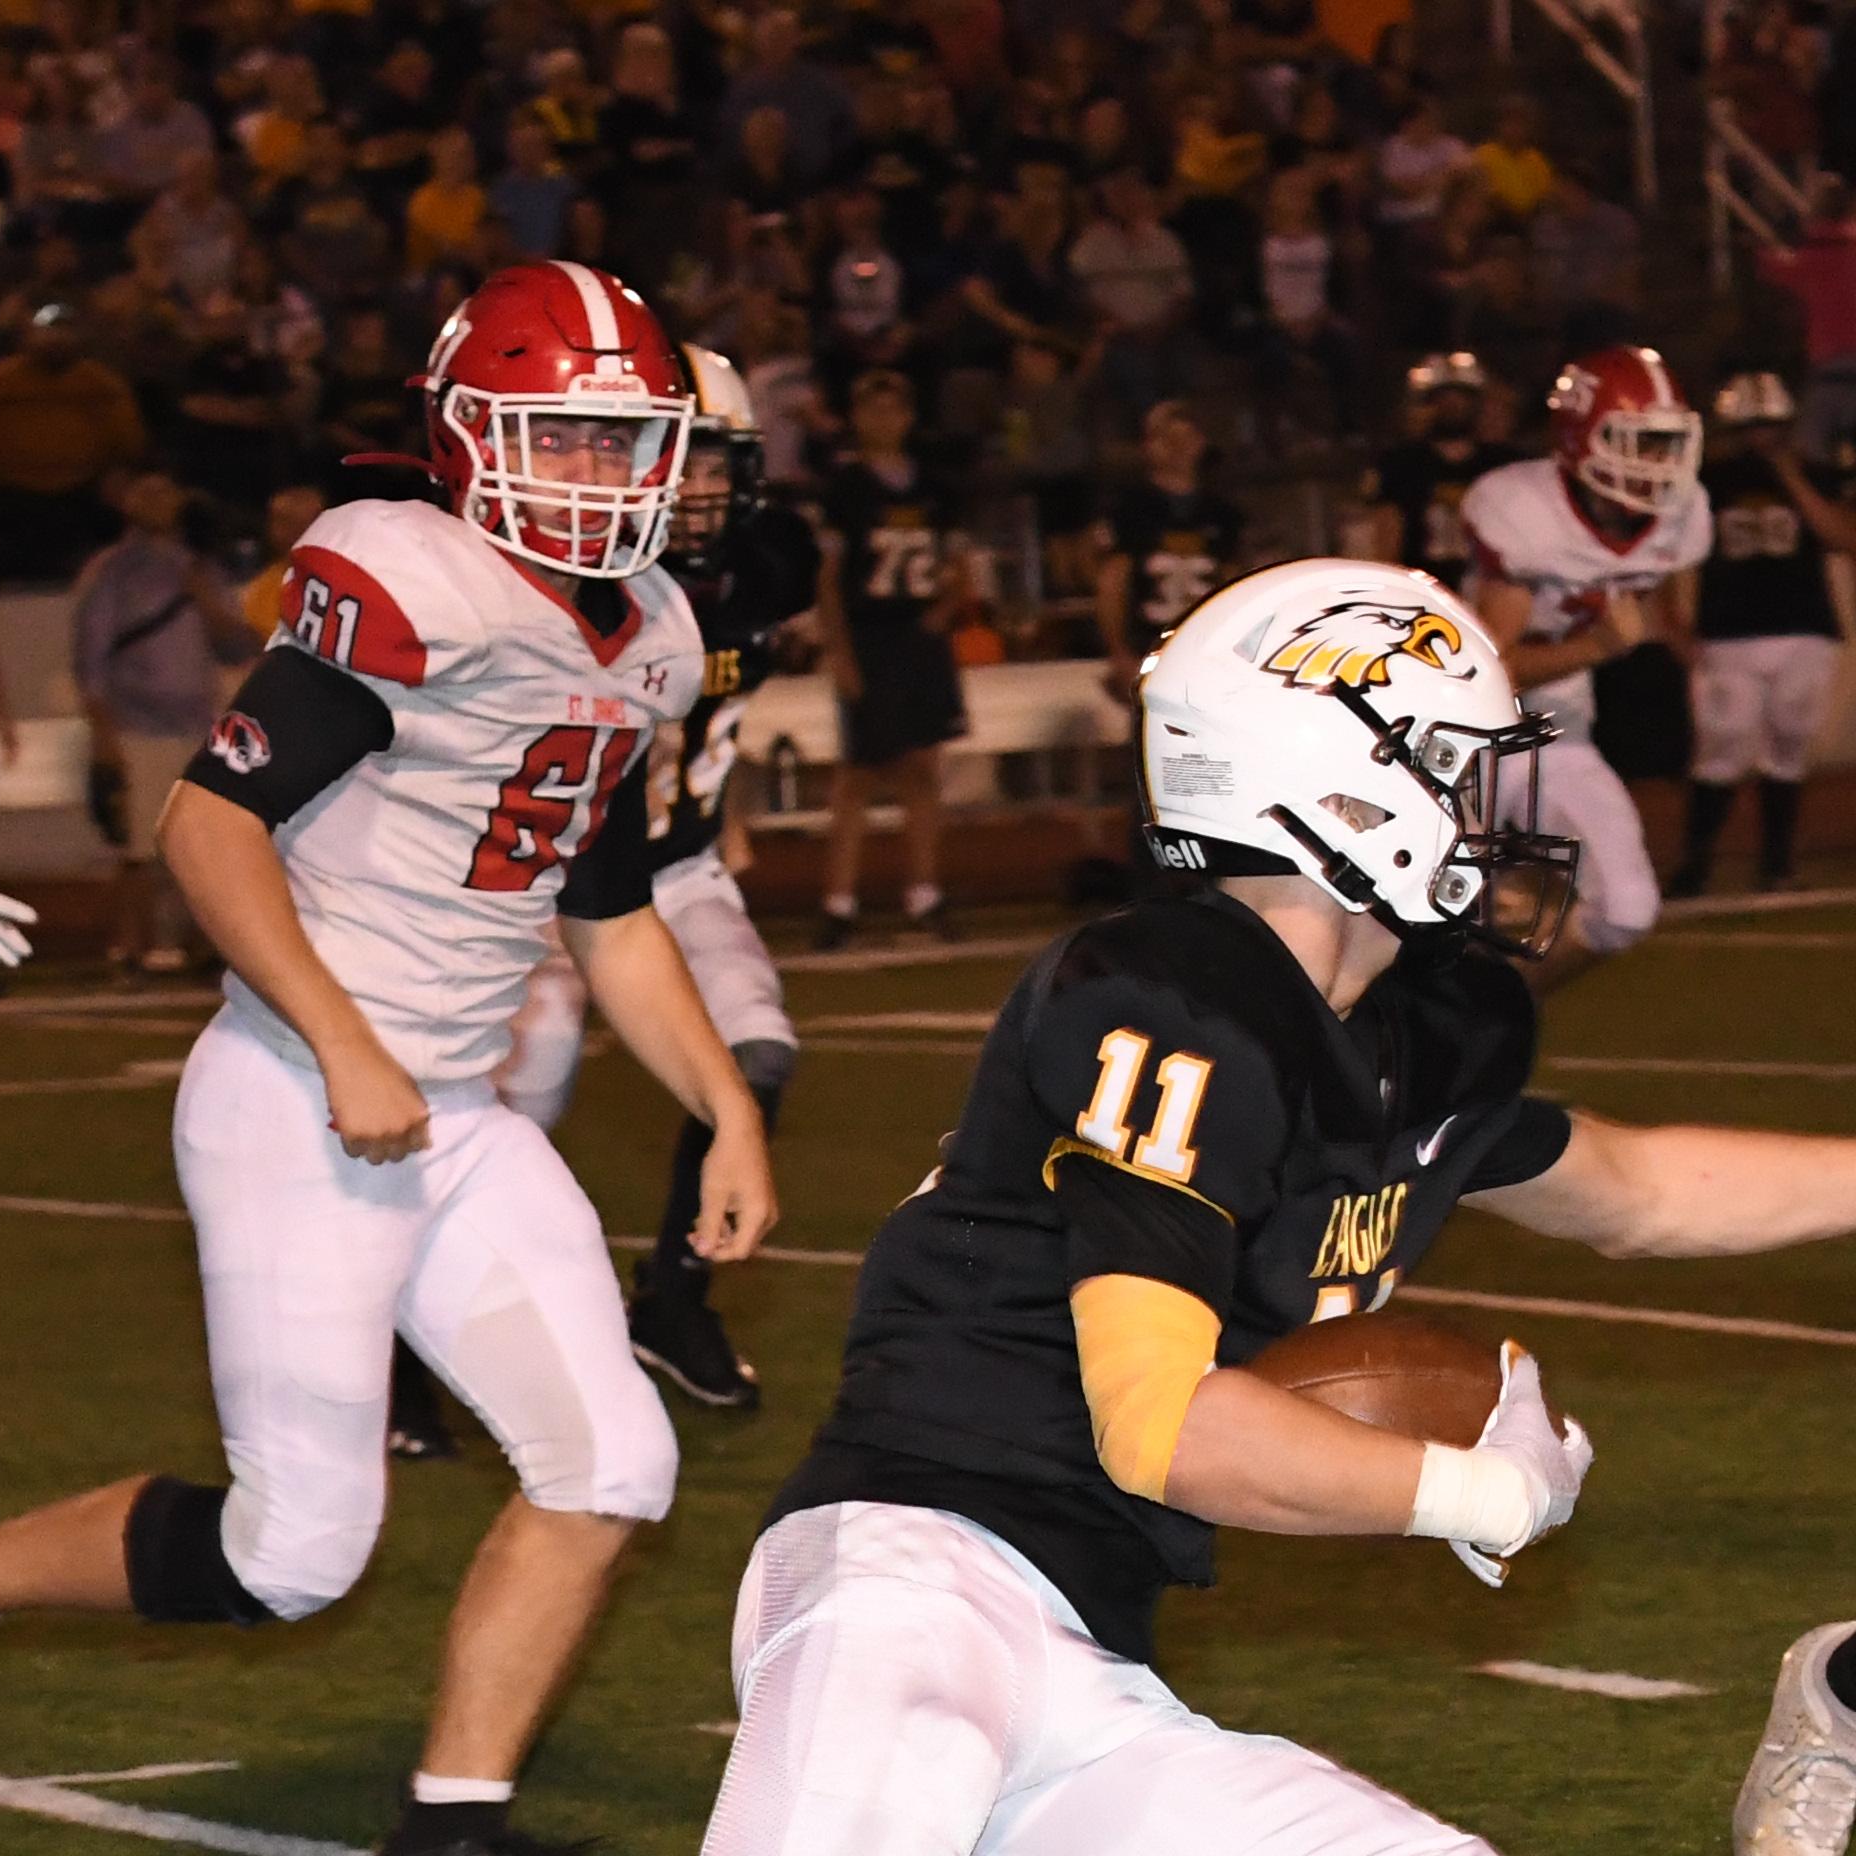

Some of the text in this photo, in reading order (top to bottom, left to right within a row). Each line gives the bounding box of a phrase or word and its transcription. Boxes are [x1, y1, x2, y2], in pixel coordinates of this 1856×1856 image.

[463, 724, 643, 891] 61
[1075, 1026, 1216, 1184] 11
[1307, 1182, 1408, 1279] EAGLES
